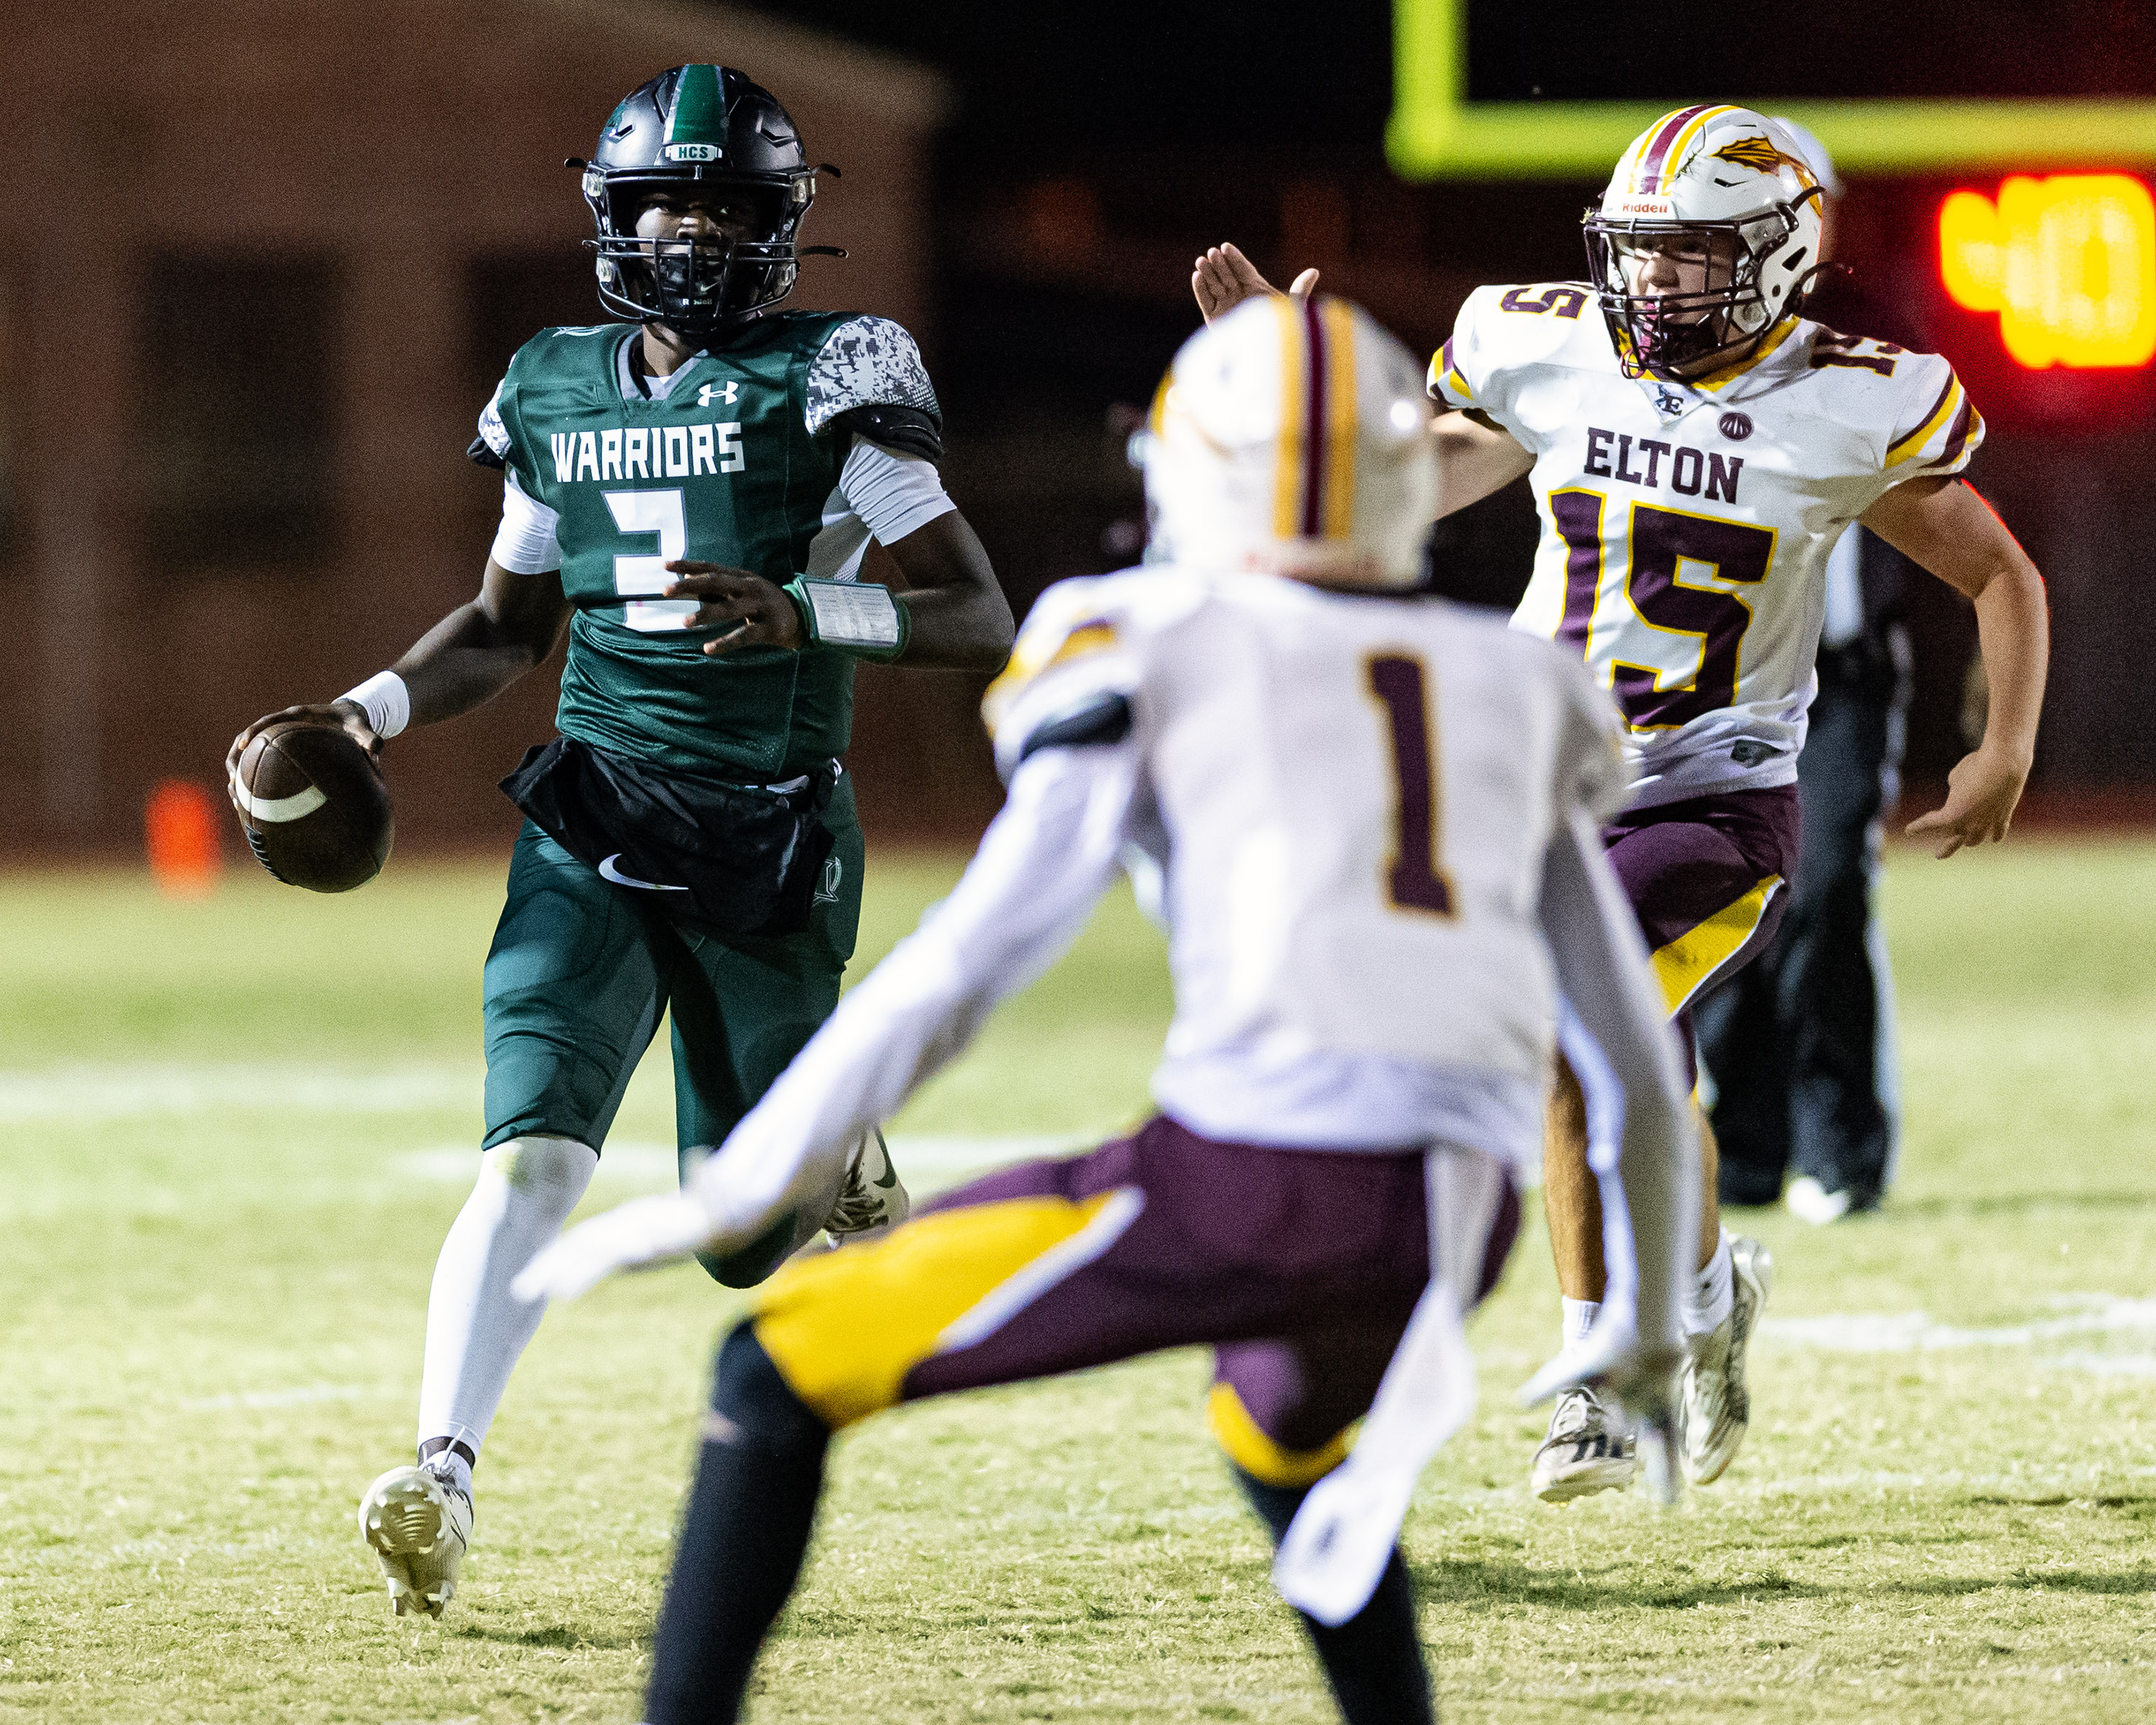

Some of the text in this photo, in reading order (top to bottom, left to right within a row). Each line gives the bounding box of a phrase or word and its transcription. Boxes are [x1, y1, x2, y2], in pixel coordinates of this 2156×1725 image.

[678, 146, 709, 159] HCS
[1622, 203, 1668, 213] Riddell
[550, 422, 745, 483] WARRIORS
[1584, 426, 1744, 504] ELTON
[600, 487, 704, 633] 3
[1548, 486, 1779, 733] 15
[1363, 650, 1456, 917] 1
